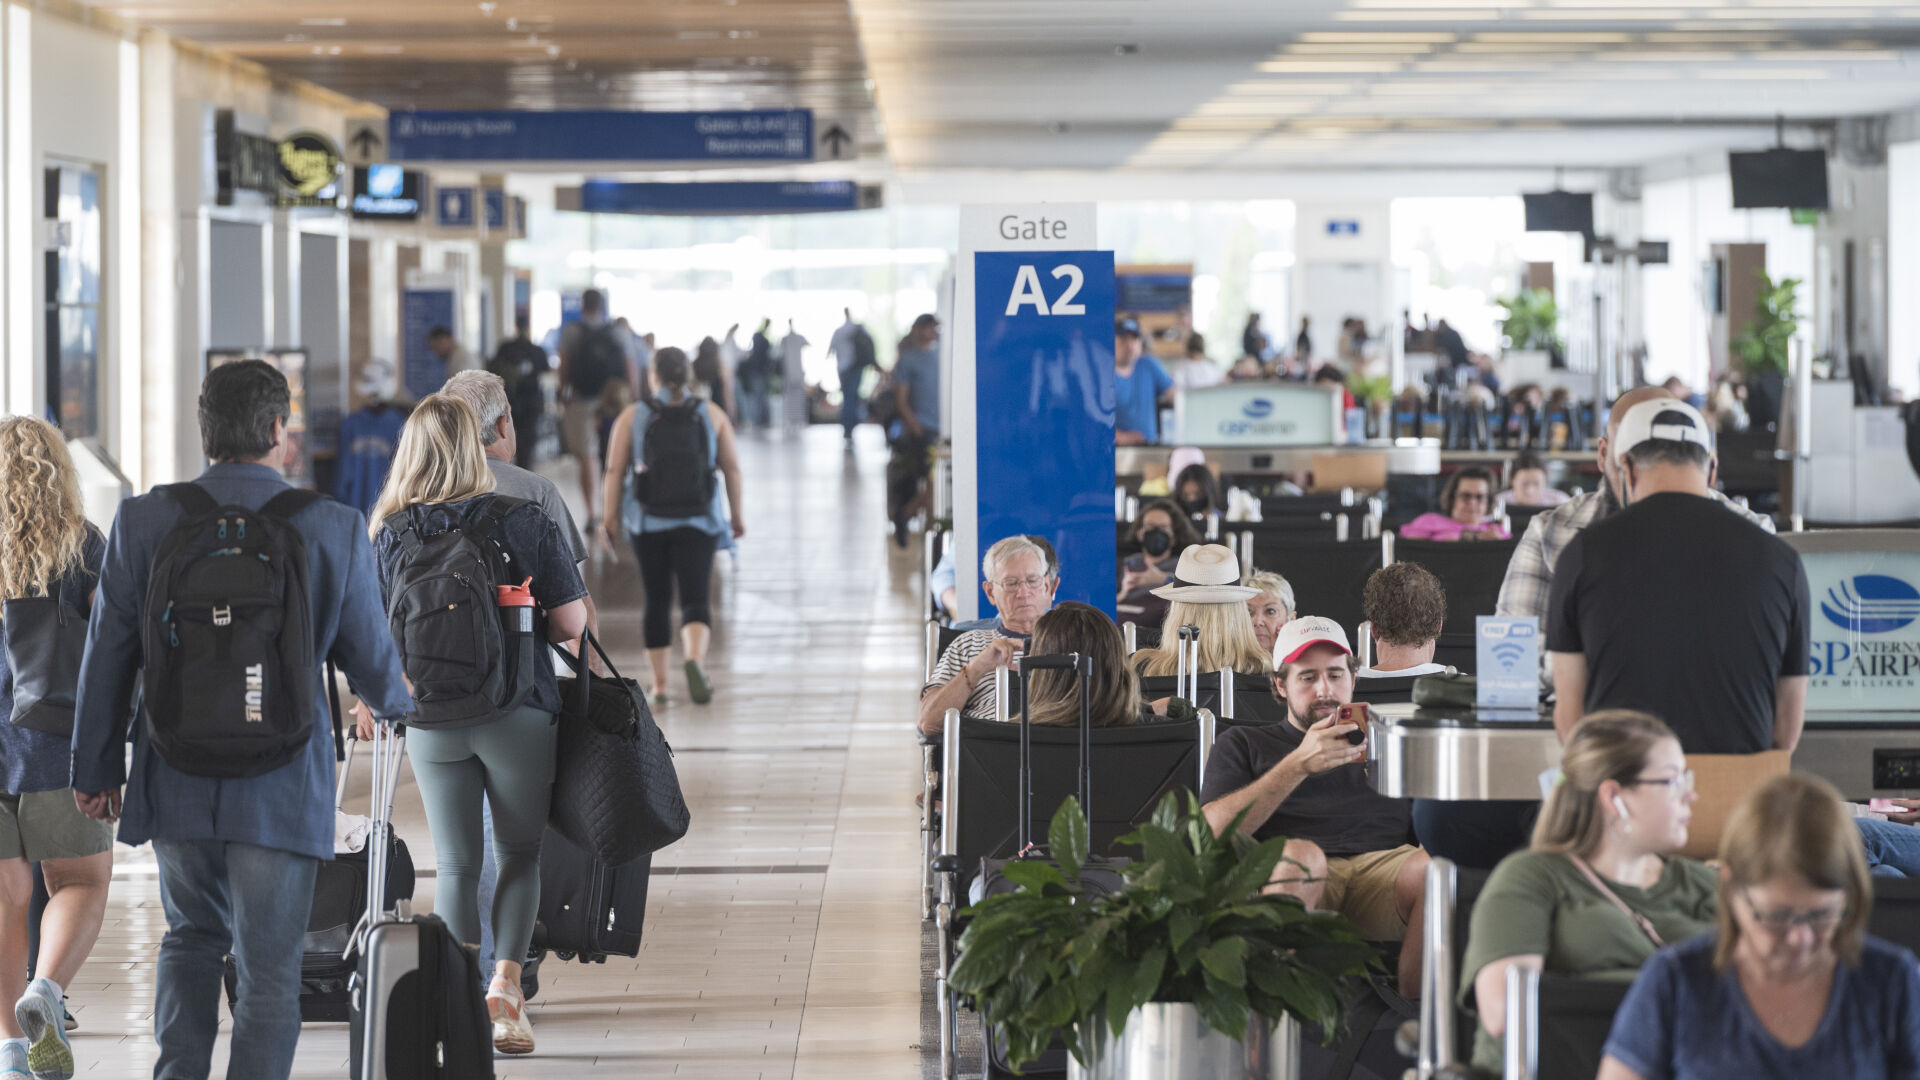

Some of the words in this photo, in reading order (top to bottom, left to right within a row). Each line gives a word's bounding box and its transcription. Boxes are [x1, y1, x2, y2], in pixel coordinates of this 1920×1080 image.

[421, 120, 473, 138] Nursing
[476, 120, 516, 135] Room
[697, 117, 739, 133] Gates
[707, 138, 784, 153] Restrooms
[999, 215, 1067, 240] Gate
[1004, 264, 1086, 316] A2
[1848, 655, 1920, 676] AIRP
[245, 663, 262, 722] THULE
[1842, 680, 1914, 688] MILLIKEN
